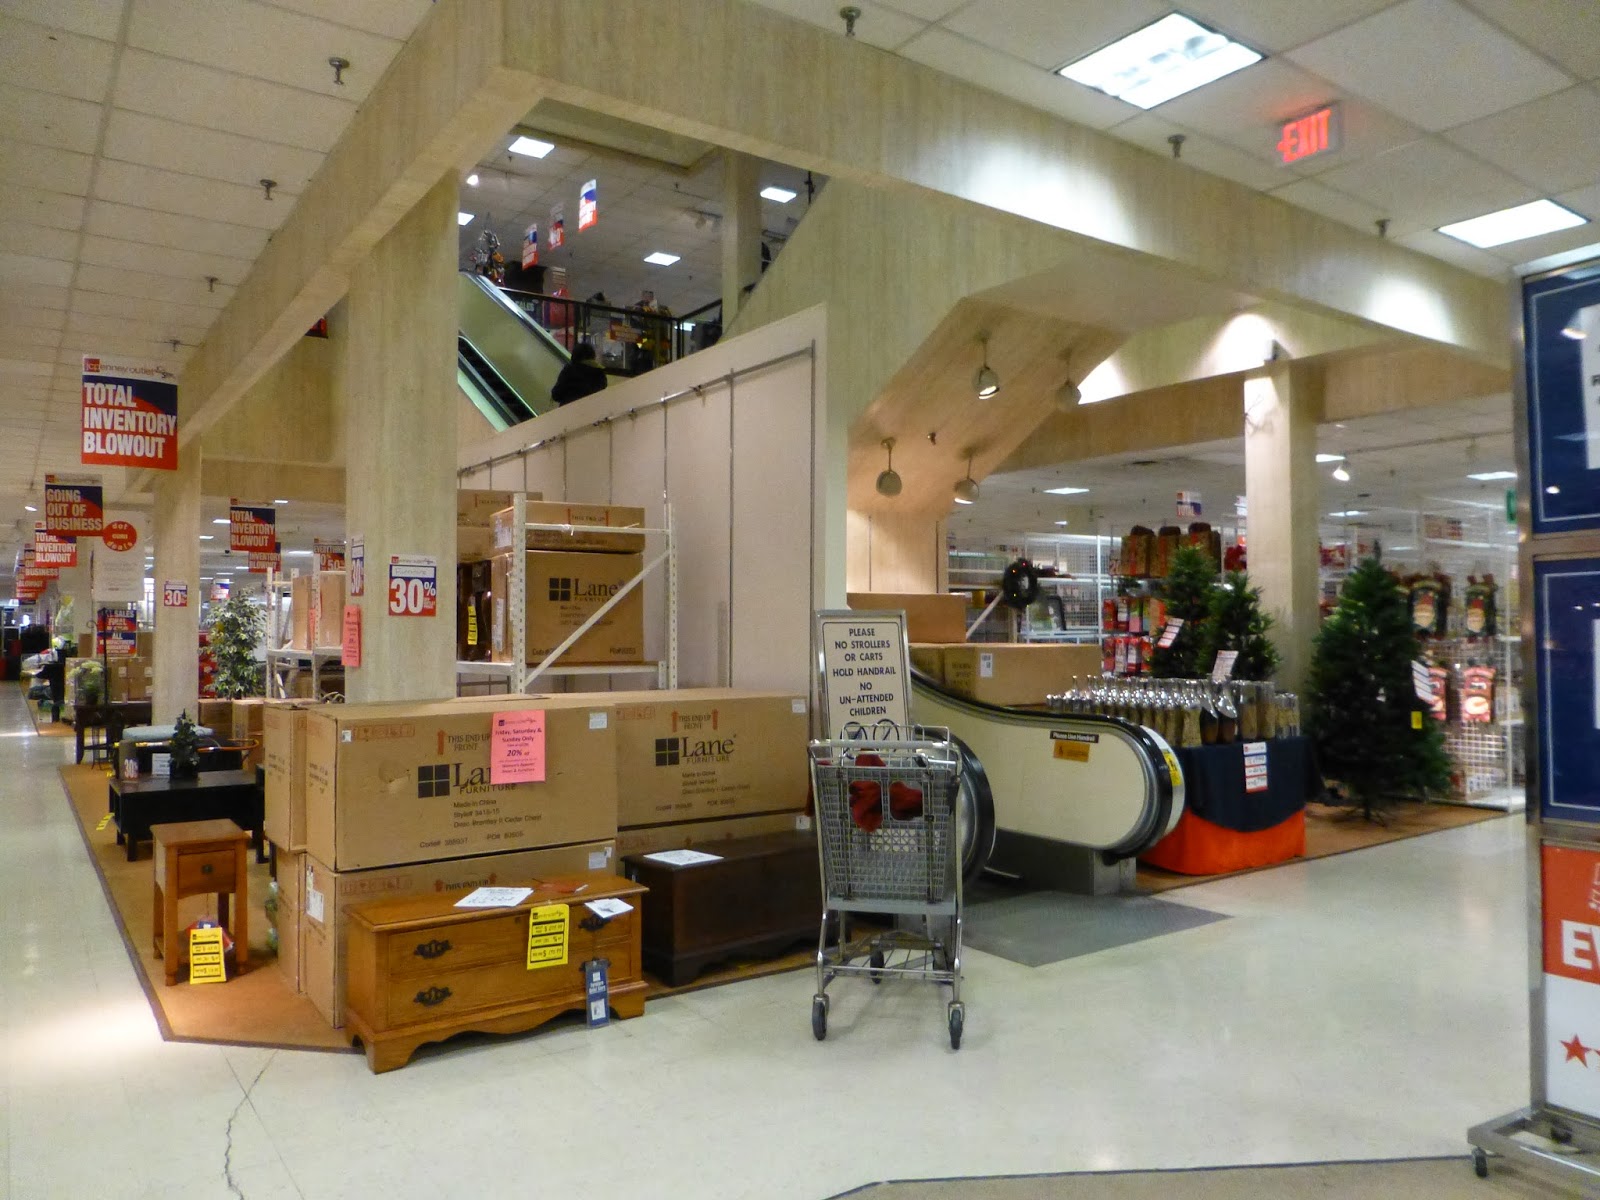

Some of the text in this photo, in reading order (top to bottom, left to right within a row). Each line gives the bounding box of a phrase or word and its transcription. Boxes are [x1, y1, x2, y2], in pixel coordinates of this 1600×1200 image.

[1278, 108, 1331, 162] EXIT
[84, 382, 137, 408] TOTAL
[84, 407, 177, 436] INVENTORY
[84, 432, 165, 459] BLOWOUT
[47, 489, 81, 503] GOING
[47, 503, 86, 517] OUT OF
[230, 510, 255, 522] TOTAL
[47, 517, 102, 531] BUSINESS
[230, 523, 275, 535] INVENTORY
[231, 535, 269, 547] BLOWOUT
[36, 543, 77, 553] INVENTORY
[36, 553, 71, 563] BLOWOUT
[573, 577, 619, 597] Lane
[390, 578, 436, 614] 30%
[849, 628, 875, 637] PLEASE
[835, 640, 890, 649] NO STROLLERS
[844, 652, 883, 661] OR CARTS
[833, 667, 896, 677] HOLD HANDRAIL
[860, 682, 872, 691] NO
[839, 693, 894, 705] UN-ATTENDED
[849, 706, 887, 716] CHILDREN
[448, 735, 464, 743] THIS
[465, 734, 481, 742] END
[454, 743, 478, 751] FRONT
[506, 749, 523, 757] 20%
[682, 736, 735, 758] Lane
[686, 756, 730, 764] FURNITURE
[459, 783, 517, 795] FURNITURE
